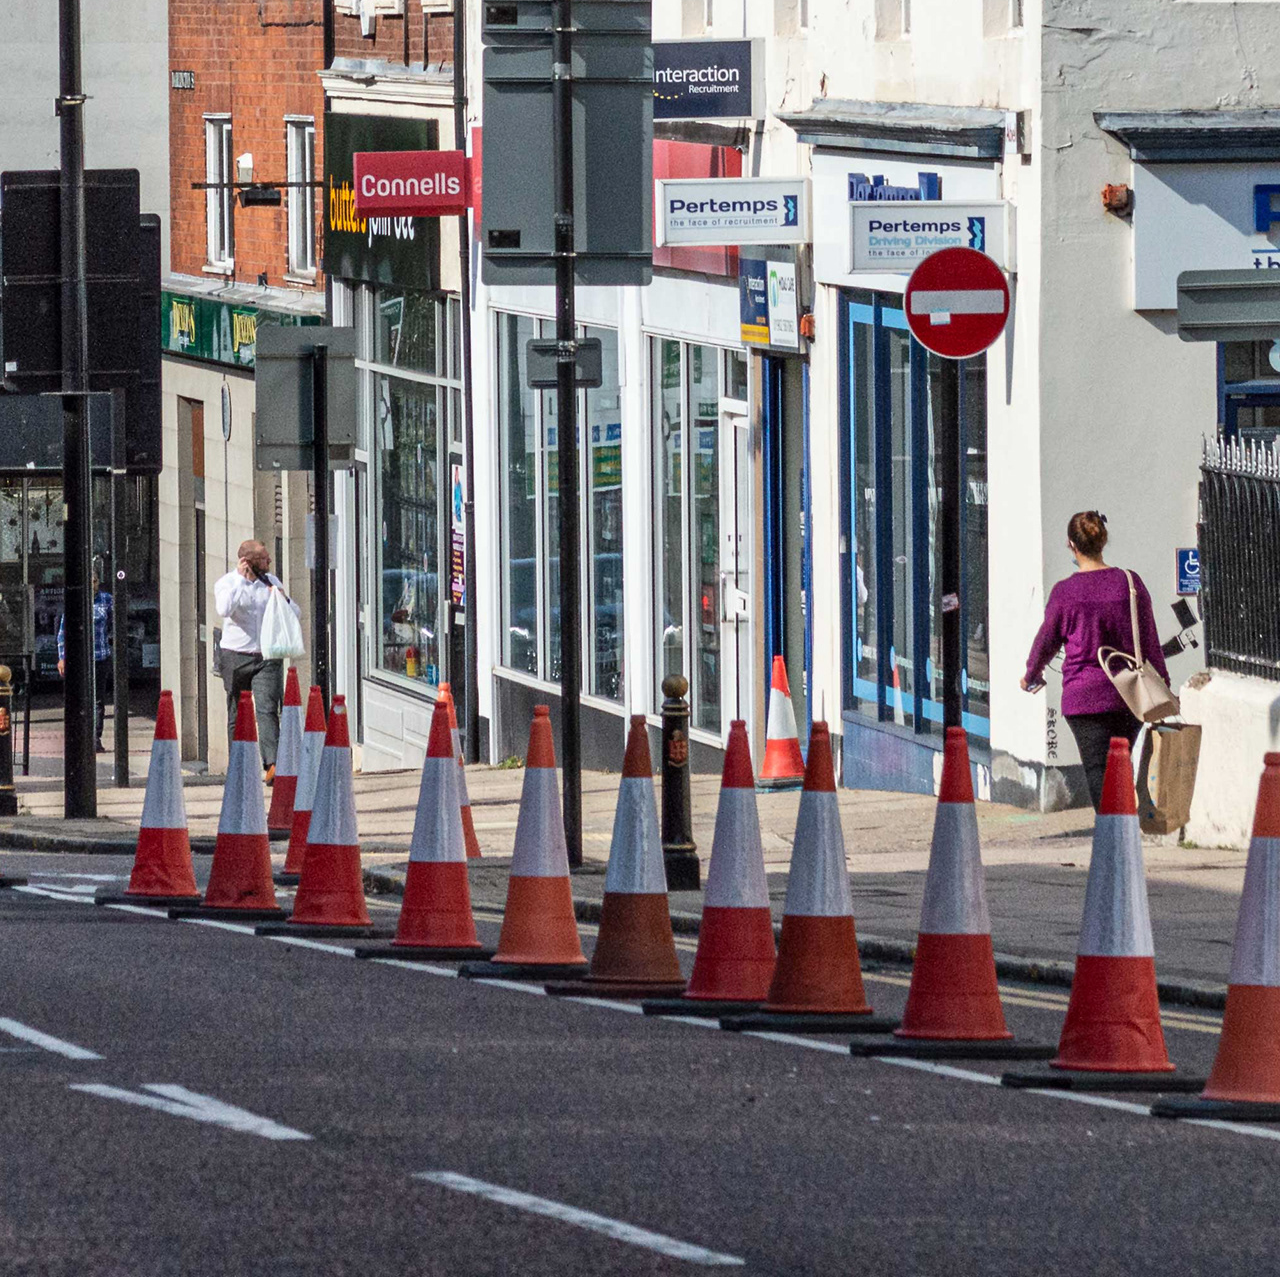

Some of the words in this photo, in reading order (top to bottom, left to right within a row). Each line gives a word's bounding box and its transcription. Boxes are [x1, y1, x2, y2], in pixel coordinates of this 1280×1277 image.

[689, 85, 740, 94] Recruitment
[361, 173, 461, 197] Connells
[670, 198, 779, 215] Pertemps
[670, 219, 685, 227] the
[711, 218, 721, 226] of
[724, 217, 779, 226] recruitment
[869, 220, 962, 235] Pertemps
[869, 236, 912, 248] Driving
[915, 235, 962, 246] Division
[868, 249, 885, 257] the
[887, 249, 907, 257] face
[910, 248, 920, 257] of
